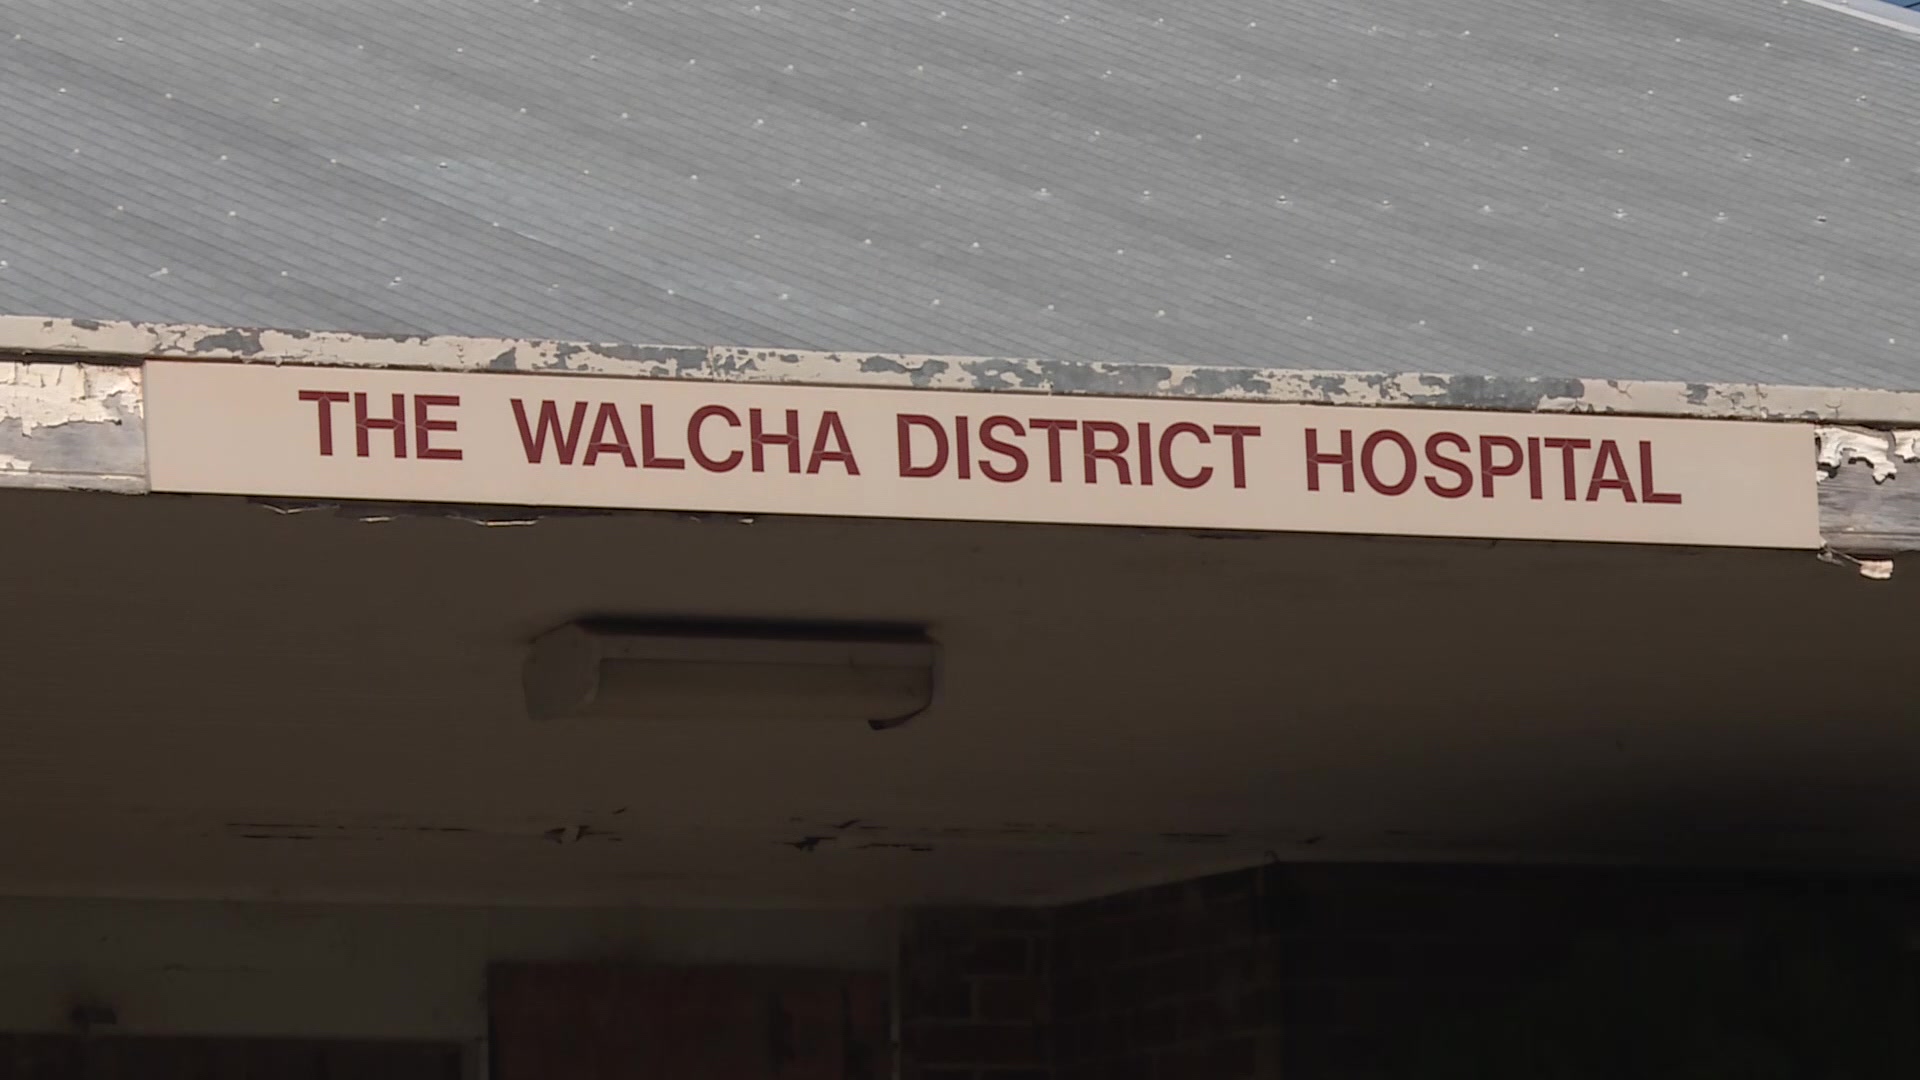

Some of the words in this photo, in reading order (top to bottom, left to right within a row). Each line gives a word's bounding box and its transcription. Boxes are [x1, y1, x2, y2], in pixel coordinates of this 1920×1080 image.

[298, 390, 463, 460] THE
[510, 398, 860, 476] WALCHA
[898, 413, 1261, 489] DISTRICT
[1305, 427, 1682, 504] HOSPITAL
